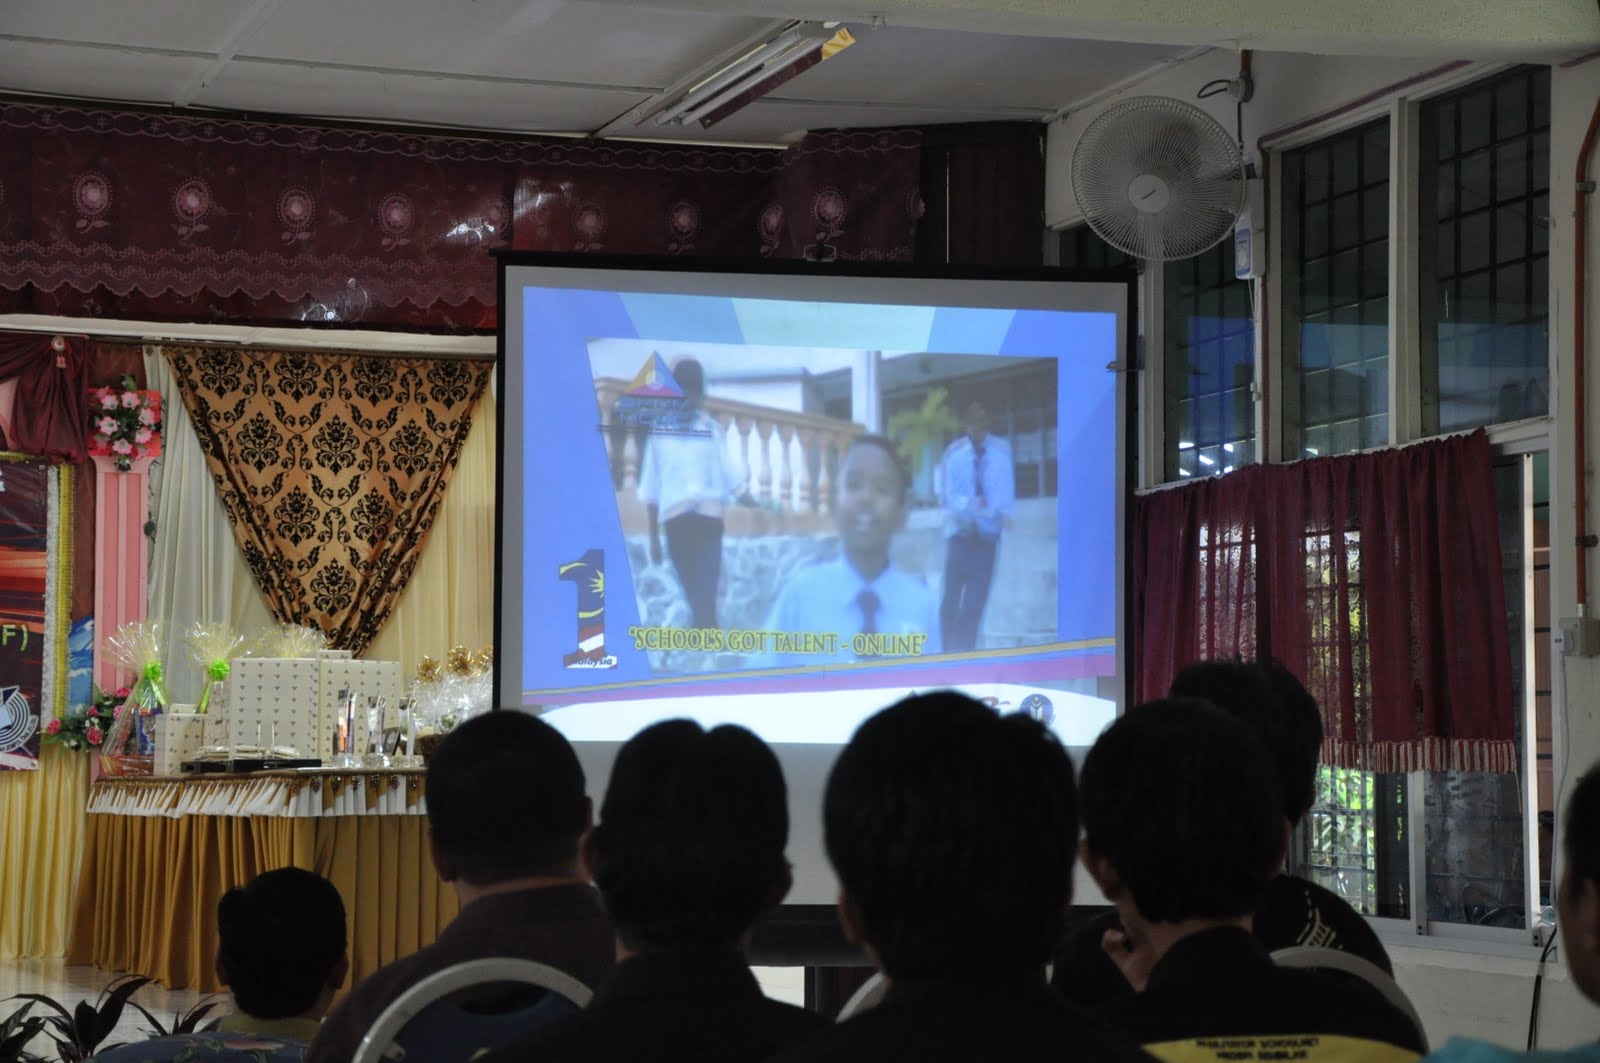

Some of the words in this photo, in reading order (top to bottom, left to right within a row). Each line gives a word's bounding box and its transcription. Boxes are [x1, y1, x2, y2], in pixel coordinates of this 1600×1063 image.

[727, 631, 768, 651] GOT
[770, 631, 838, 654] TALENT
[570, 657, 613, 668] alaysia
